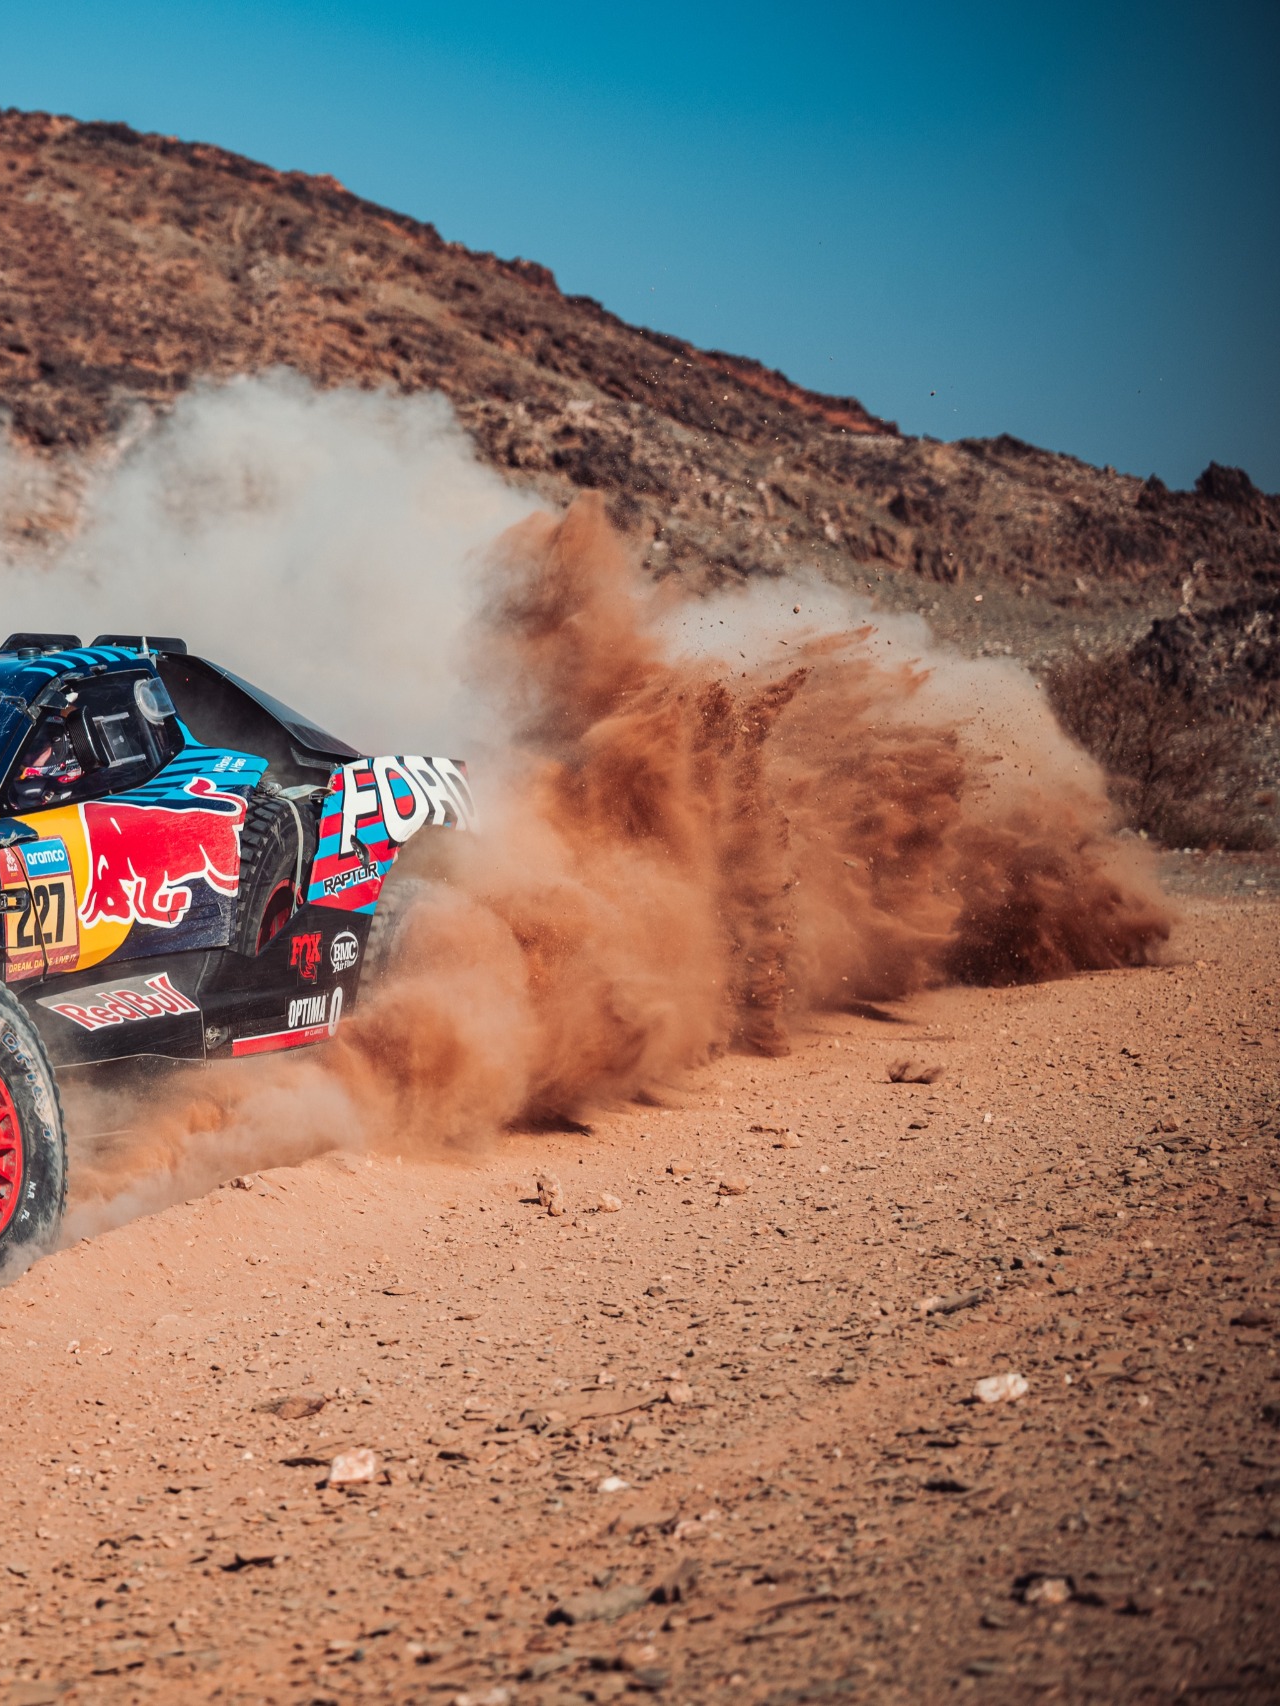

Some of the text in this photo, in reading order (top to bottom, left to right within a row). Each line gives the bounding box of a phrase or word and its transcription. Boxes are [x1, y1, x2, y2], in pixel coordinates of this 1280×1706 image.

[340, 755, 480, 855] FORD
[26, 849, 65, 866] aramco
[323, 862, 381, 897] RAPTOR
[15, 882, 66, 949] 227
[34, 957, 53, 968] DAE.
[290, 933, 322, 966] FOX
[333, 941, 356, 962] BMC
[332, 961, 344, 974] Air
[288, 995, 326, 1028] OPTIMA
